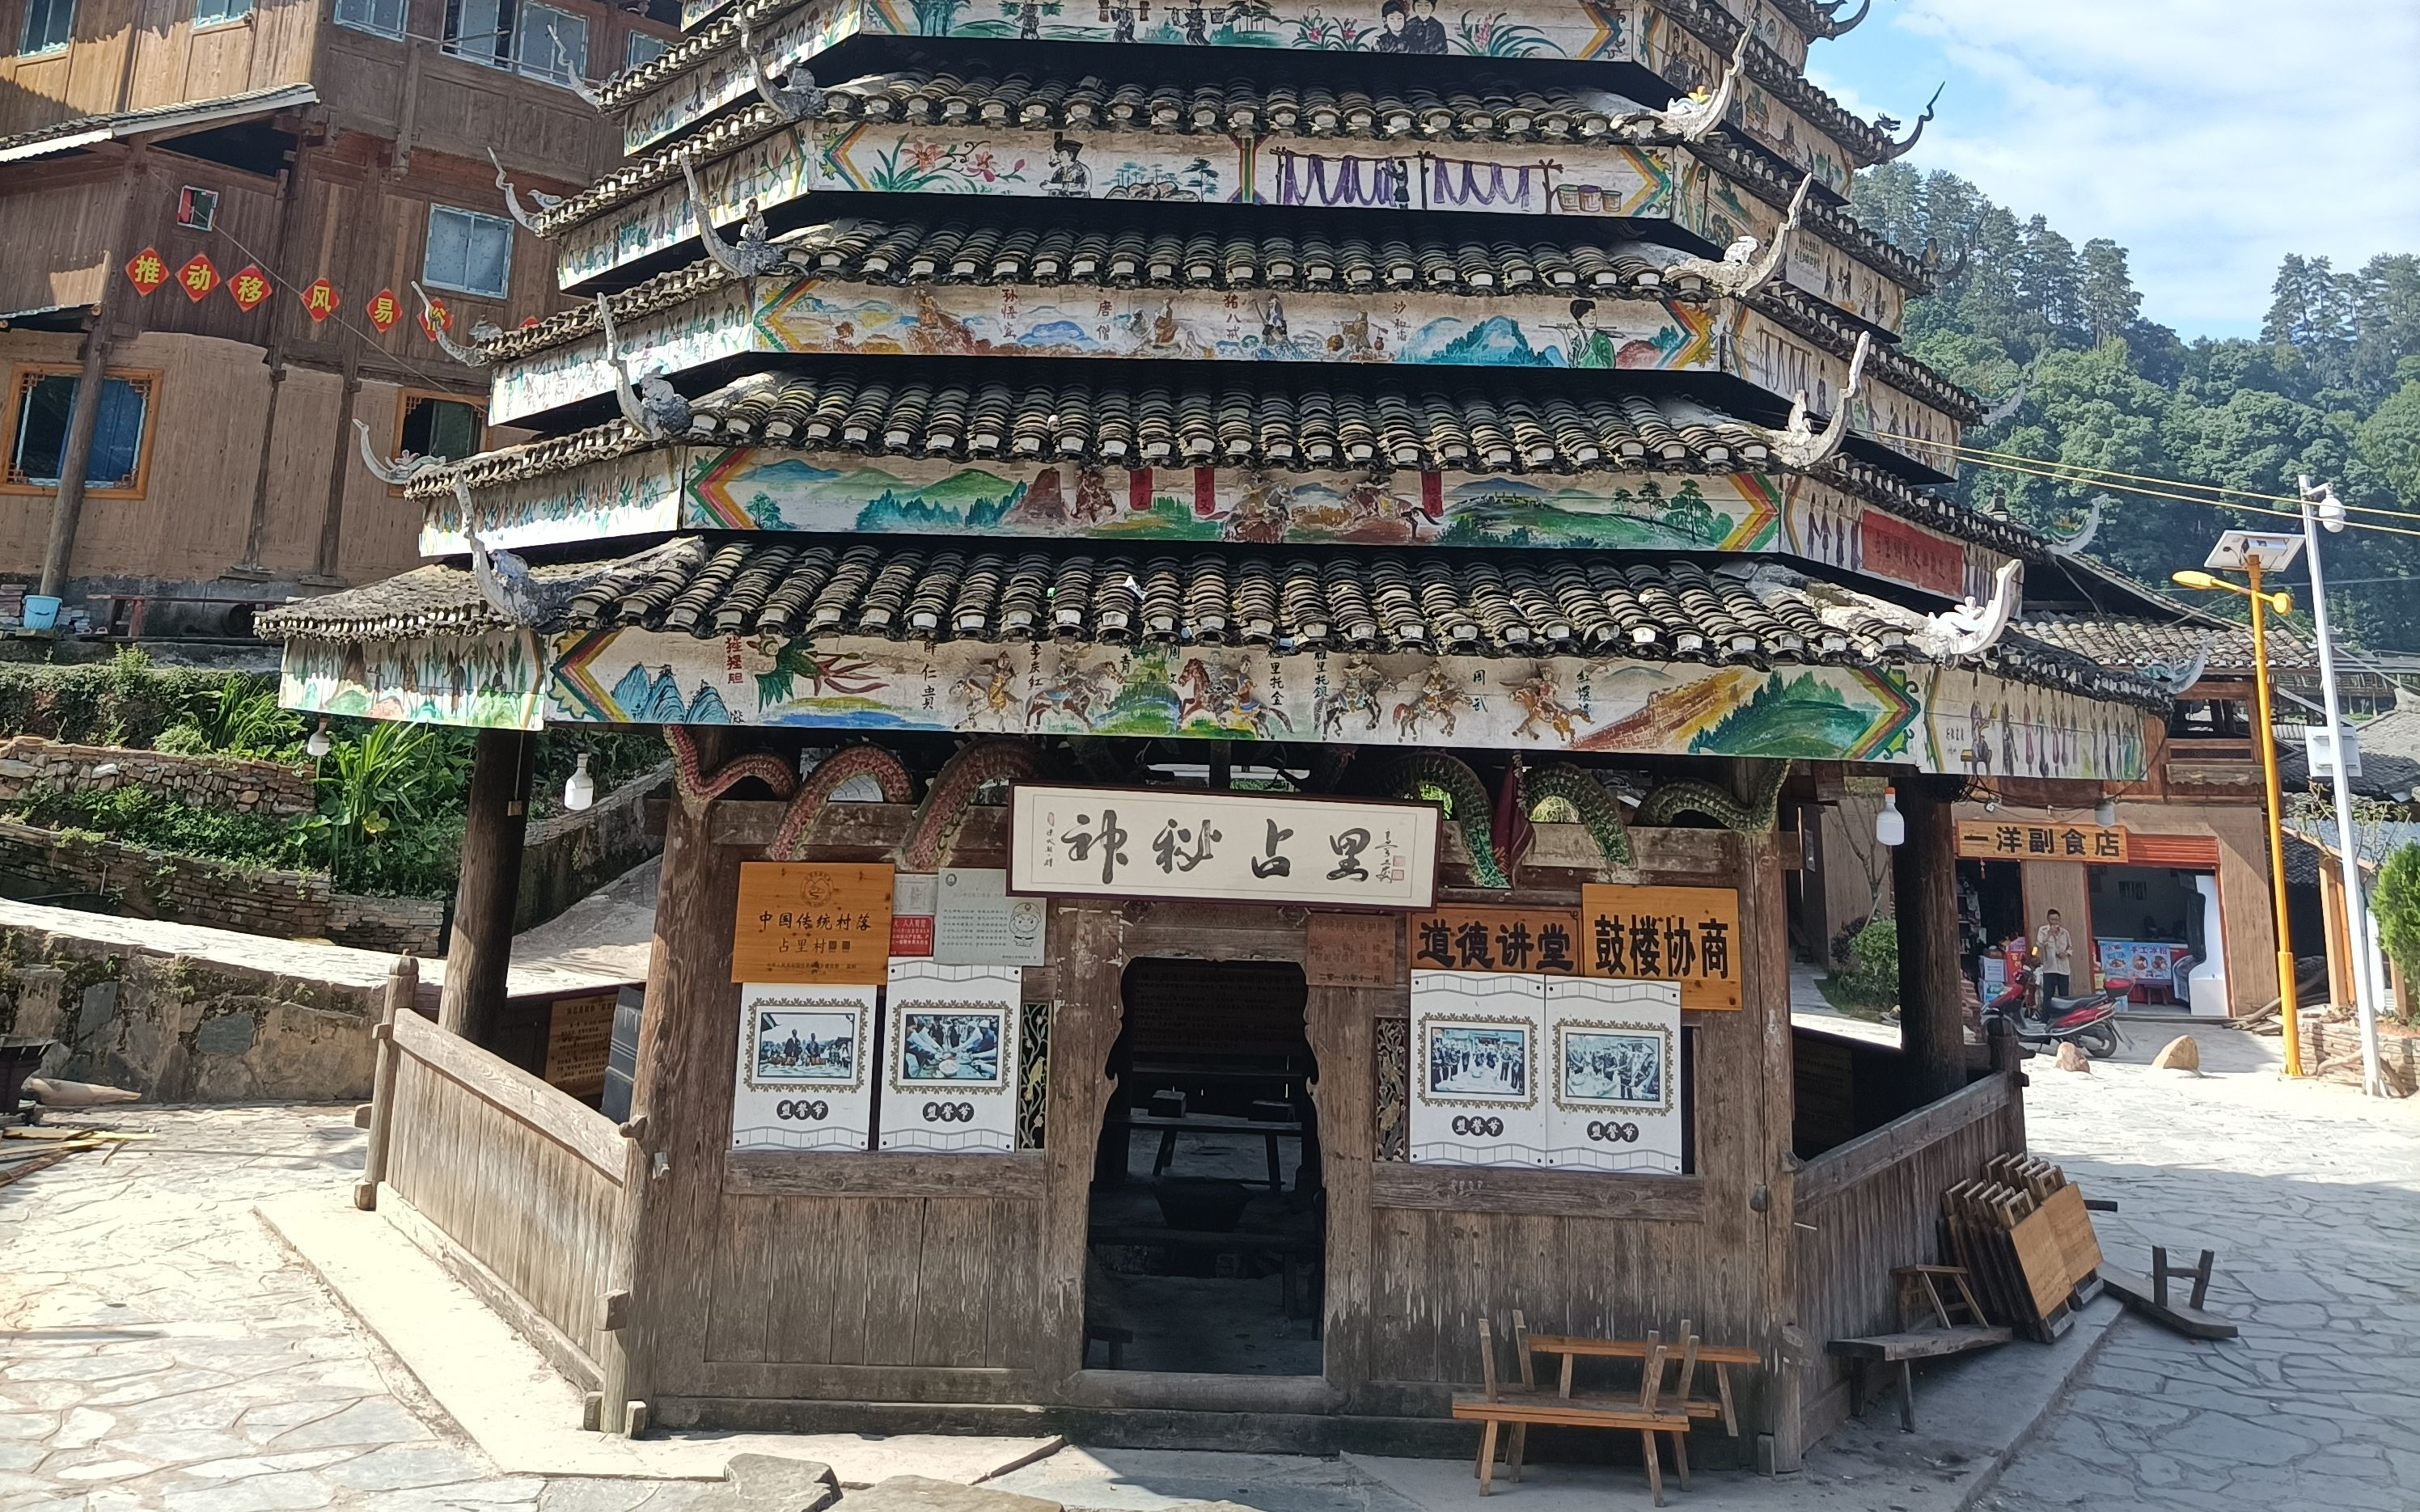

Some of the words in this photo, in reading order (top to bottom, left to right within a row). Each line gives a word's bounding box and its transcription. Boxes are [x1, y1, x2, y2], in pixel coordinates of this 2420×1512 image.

[1096, 299, 1113, 341] 唐僧
[1224, 294, 1241, 340] 猪八戒
[1964, 826, 2121, 857] 一洋副食店
[759, 910, 872, 931] 中国传统村落
[778, 937, 827, 953] 占里村
[1416, 919, 1574, 972] 道德讲堂
[1593, 913, 1729, 979] 鼓楼协商
[778, 1100, 827, 1121] 盟誓节
[924, 1102, 974, 1122] 盟誓节
[1453, 1116, 1504, 1136] 盟誓节
[1588, 1121, 1639, 1142] 盟誓节
